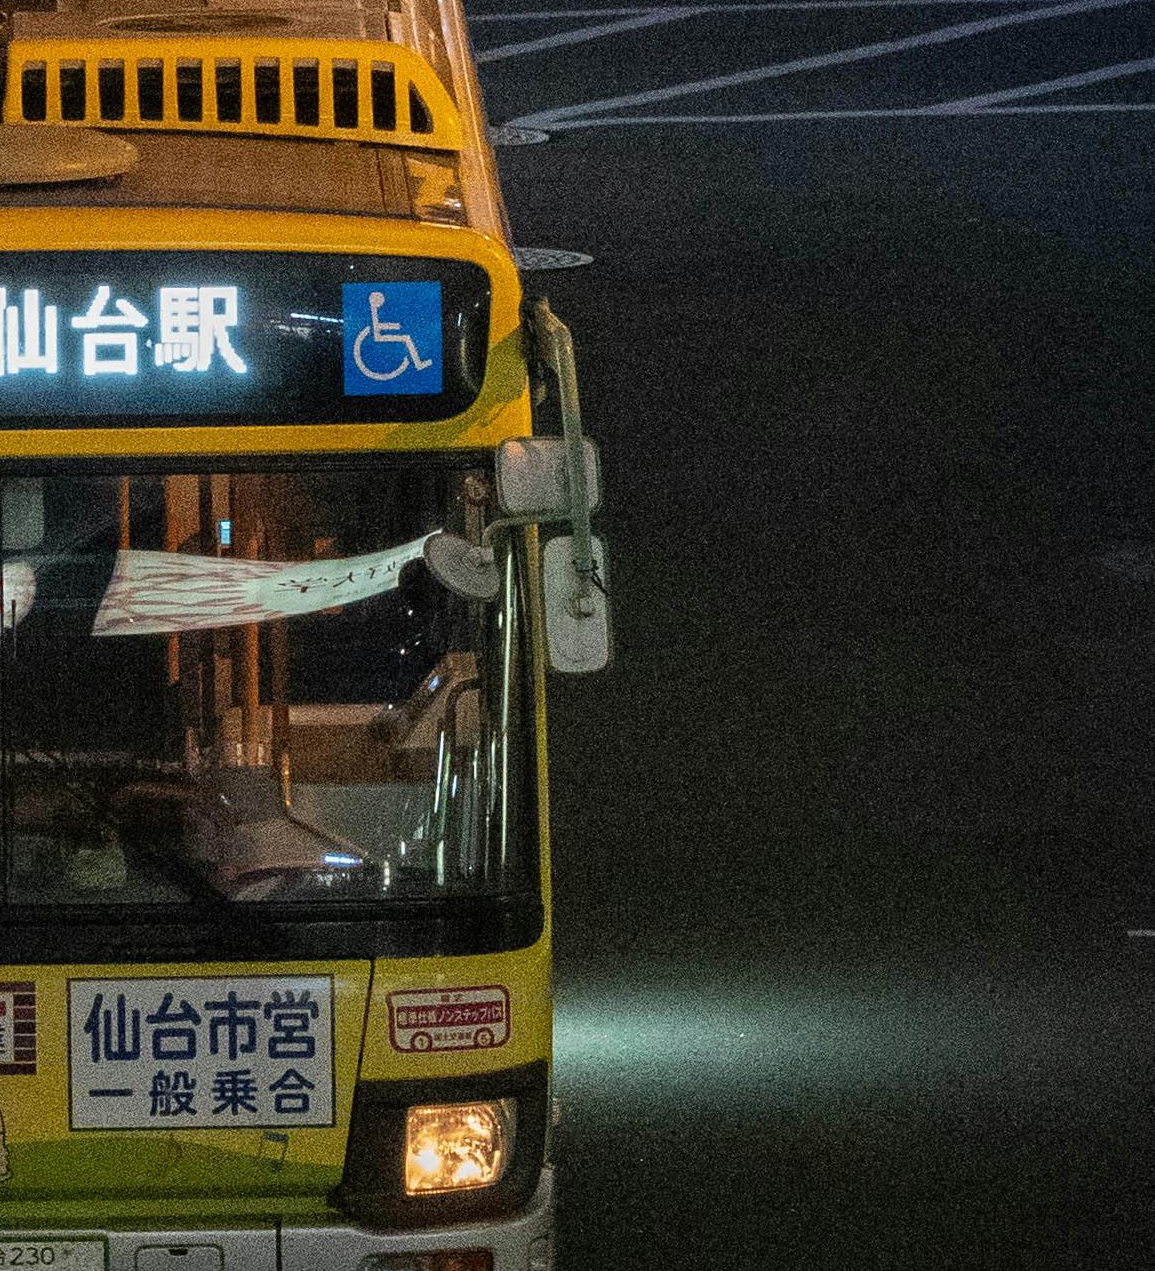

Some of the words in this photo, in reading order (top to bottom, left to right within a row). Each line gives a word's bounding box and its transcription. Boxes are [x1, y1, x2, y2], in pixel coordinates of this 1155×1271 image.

[84, 989, 318, 1063] 仙台市営
[88, 1068, 316, 1116] 一般乗合
